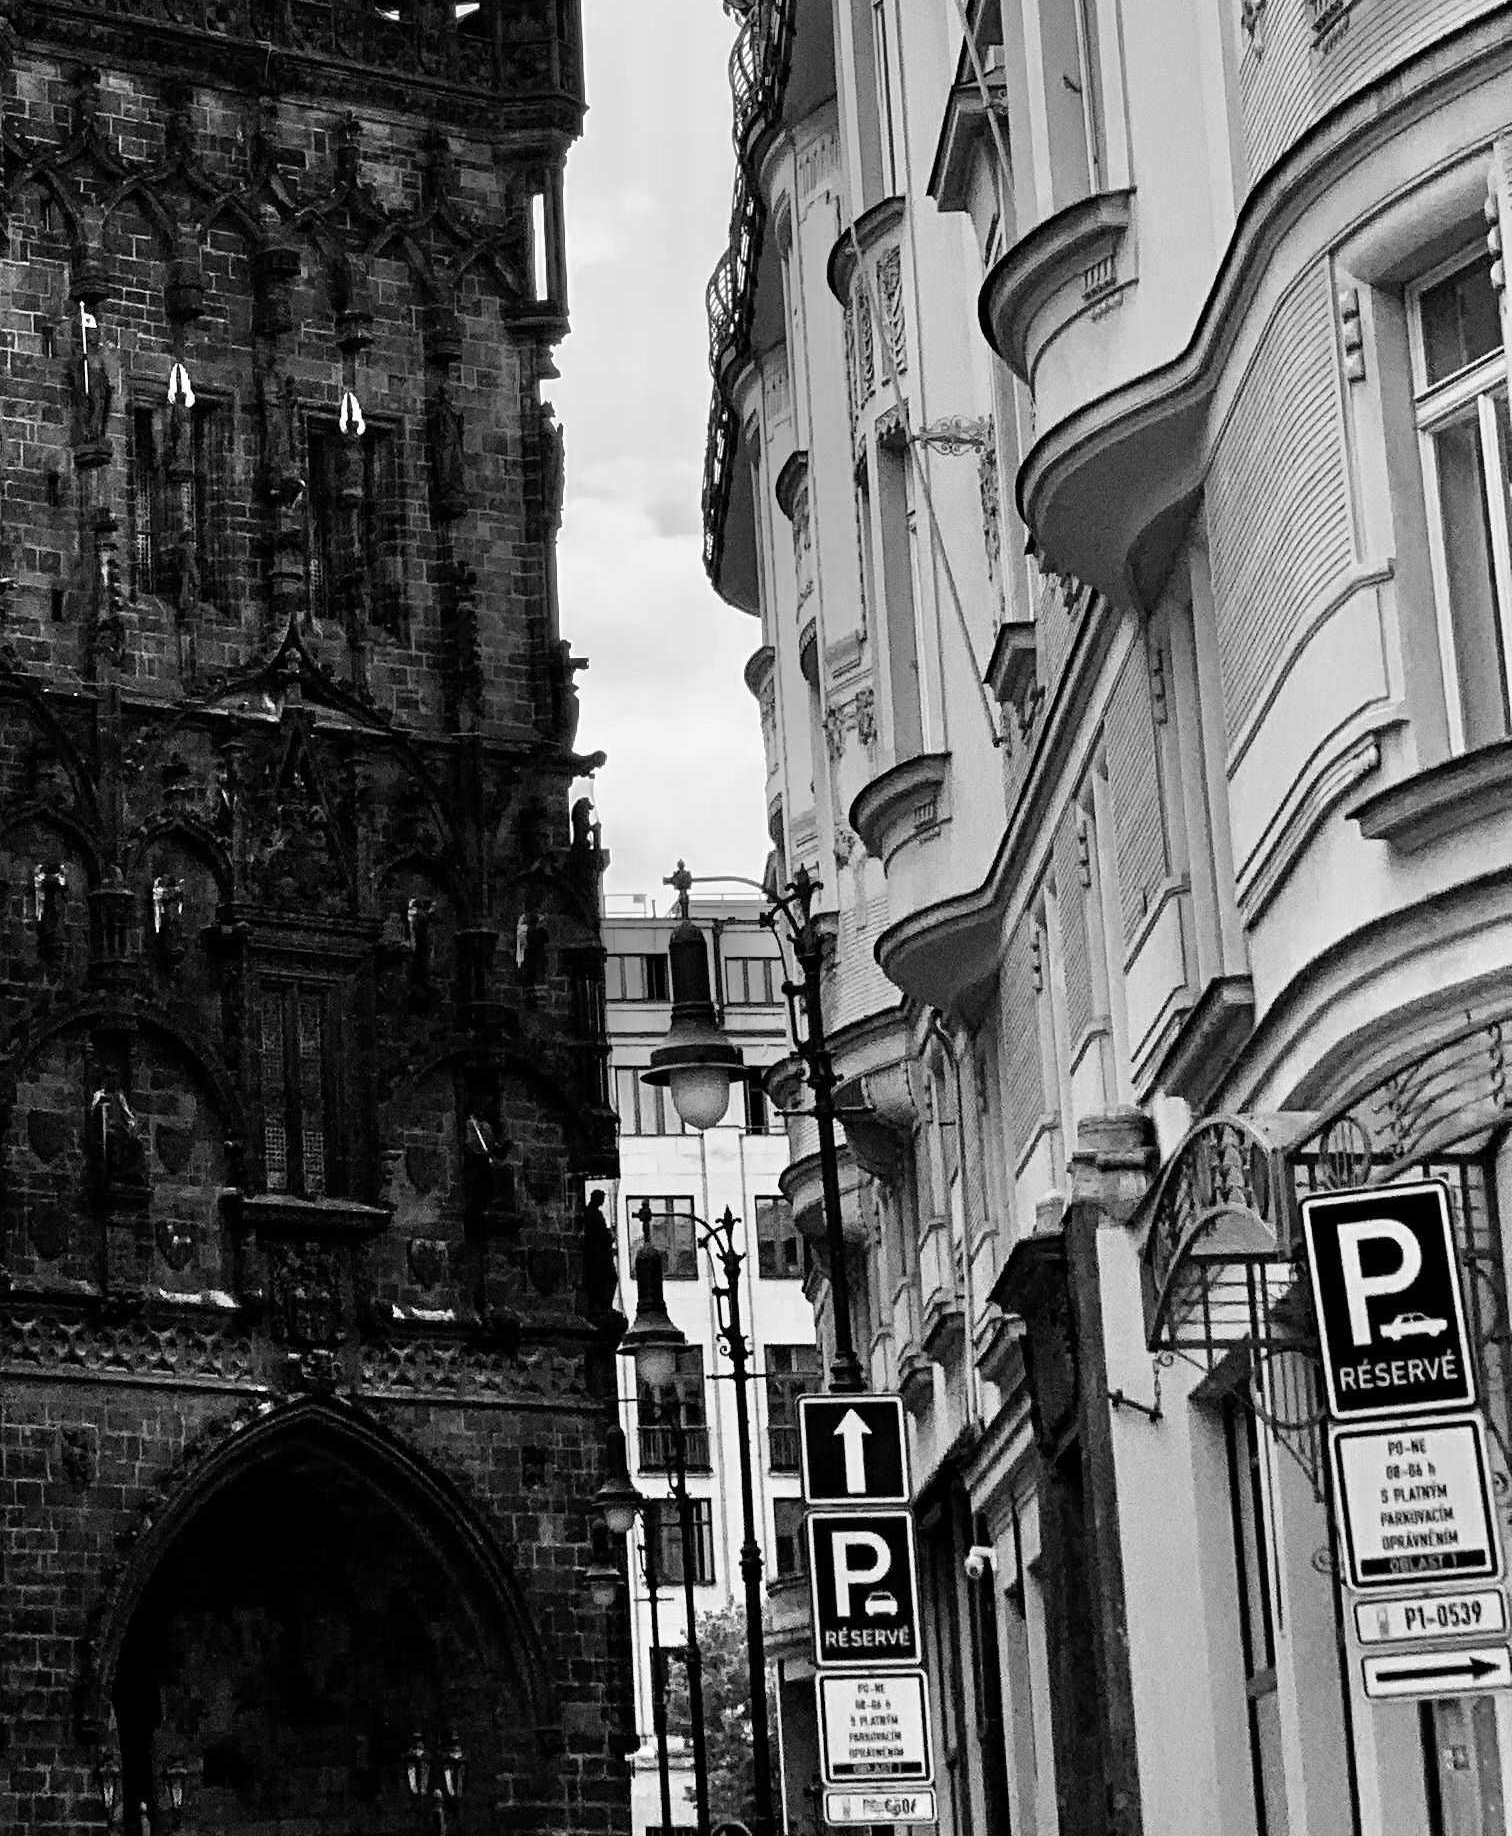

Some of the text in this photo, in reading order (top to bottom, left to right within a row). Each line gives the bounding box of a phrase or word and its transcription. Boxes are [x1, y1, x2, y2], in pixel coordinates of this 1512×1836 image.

[1337, 1218, 1422, 1346] P
[1339, 1348, 1459, 1392] RÉSERVÉ
[1388, 1438, 1427, 1456] PO-NE
[832, 1530, 891, 1617] P
[1404, 1600, 1482, 1631] P1-0539
[825, 1625, 910, 1648] RÉSERVÉ
